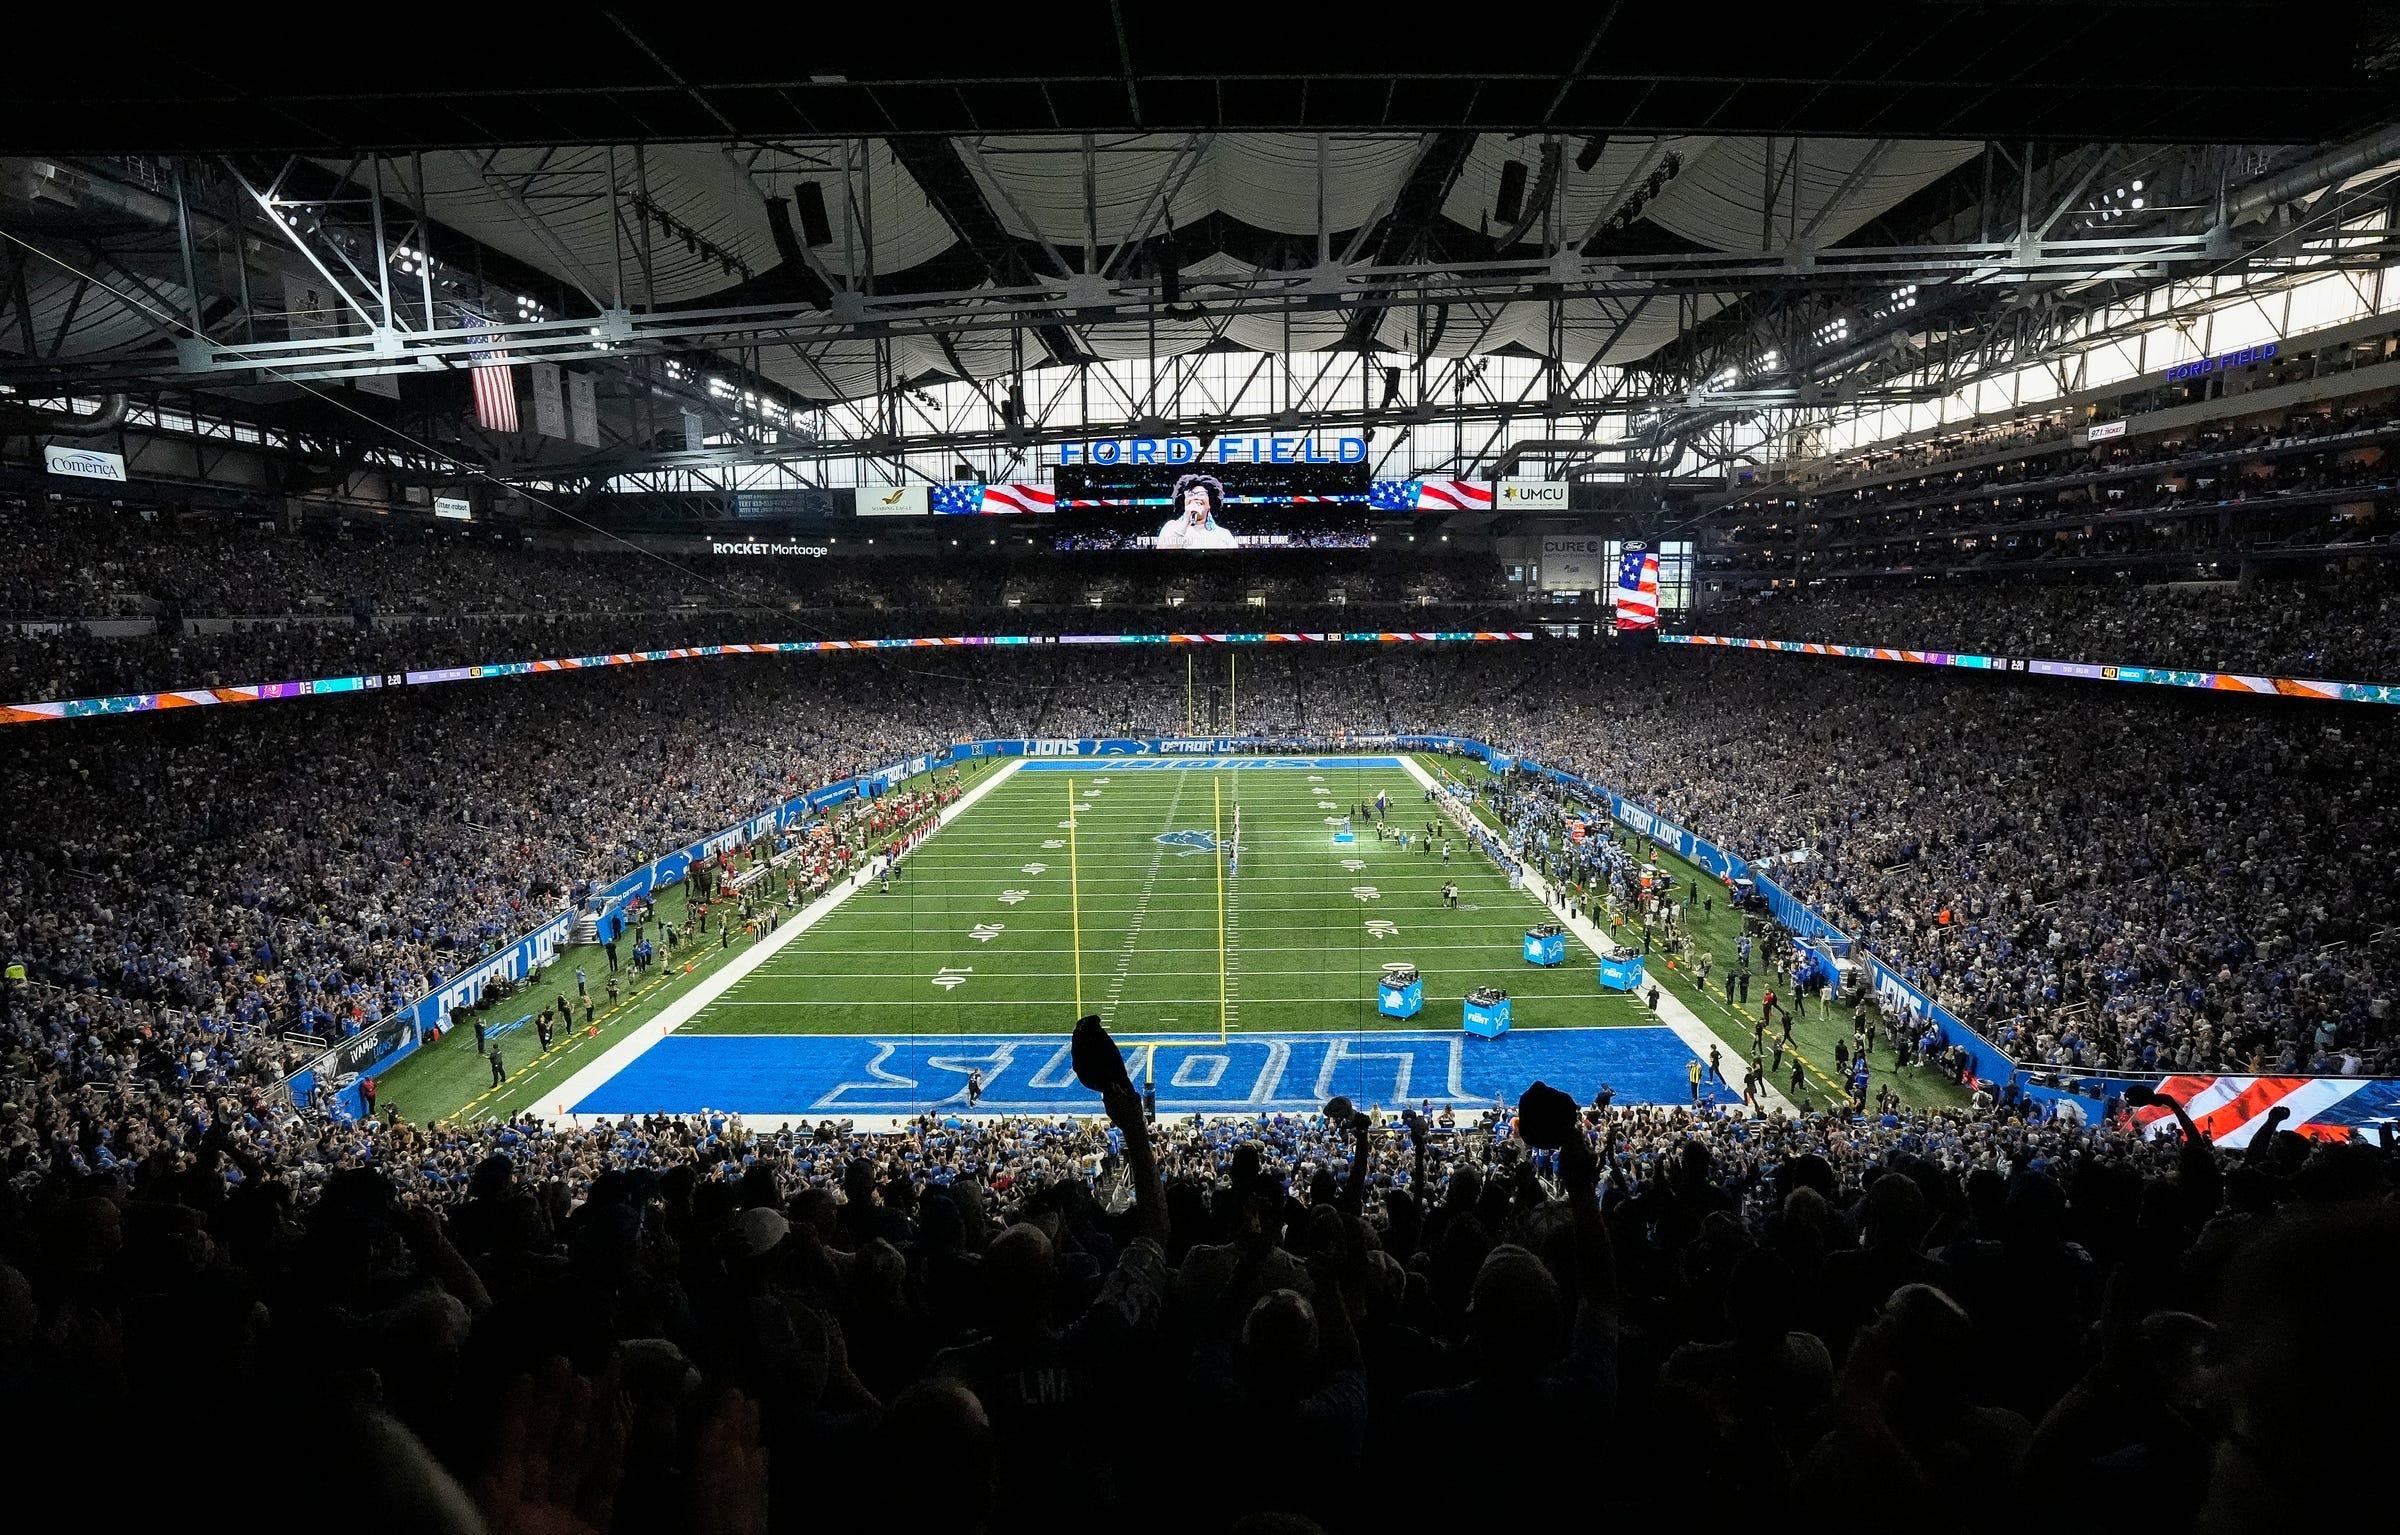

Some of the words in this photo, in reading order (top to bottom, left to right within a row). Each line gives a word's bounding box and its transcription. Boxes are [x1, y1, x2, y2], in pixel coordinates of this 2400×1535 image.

[2166, 359, 2213, 382] FORD
[2220, 343, 2277, 369] FIELD
[1060, 438, 1194, 465] FORD
[1218, 437, 1367, 464] FIELD
[1520, 488, 1564, 500] UMCU
[713, 543, 768, 555] ROCKET
[1544, 541, 1585, 552] CURE
[2011, 659, 2024, 671] 2:20
[2103, 667, 2116, 678] 40
[387, 674, 402, 685] 2:20
[1023, 739, 1080, 756] LIONS
[1160, 740, 1214, 753] DETROIT
[1620, 801, 1654, 835] DETROIT
[1654, 819, 1683, 852] LIONS
[997, 889, 1031, 902] 30
[968, 923, 1005, 938] 20
[438, 947, 520, 1018] DETROIT
[525, 917, 569, 970] LIONS
[931, 966, 974, 985] 10
[1467, 1013, 1490, 1025] FIGHT
[350, 1034, 379, 1064] ¡VAMOS
